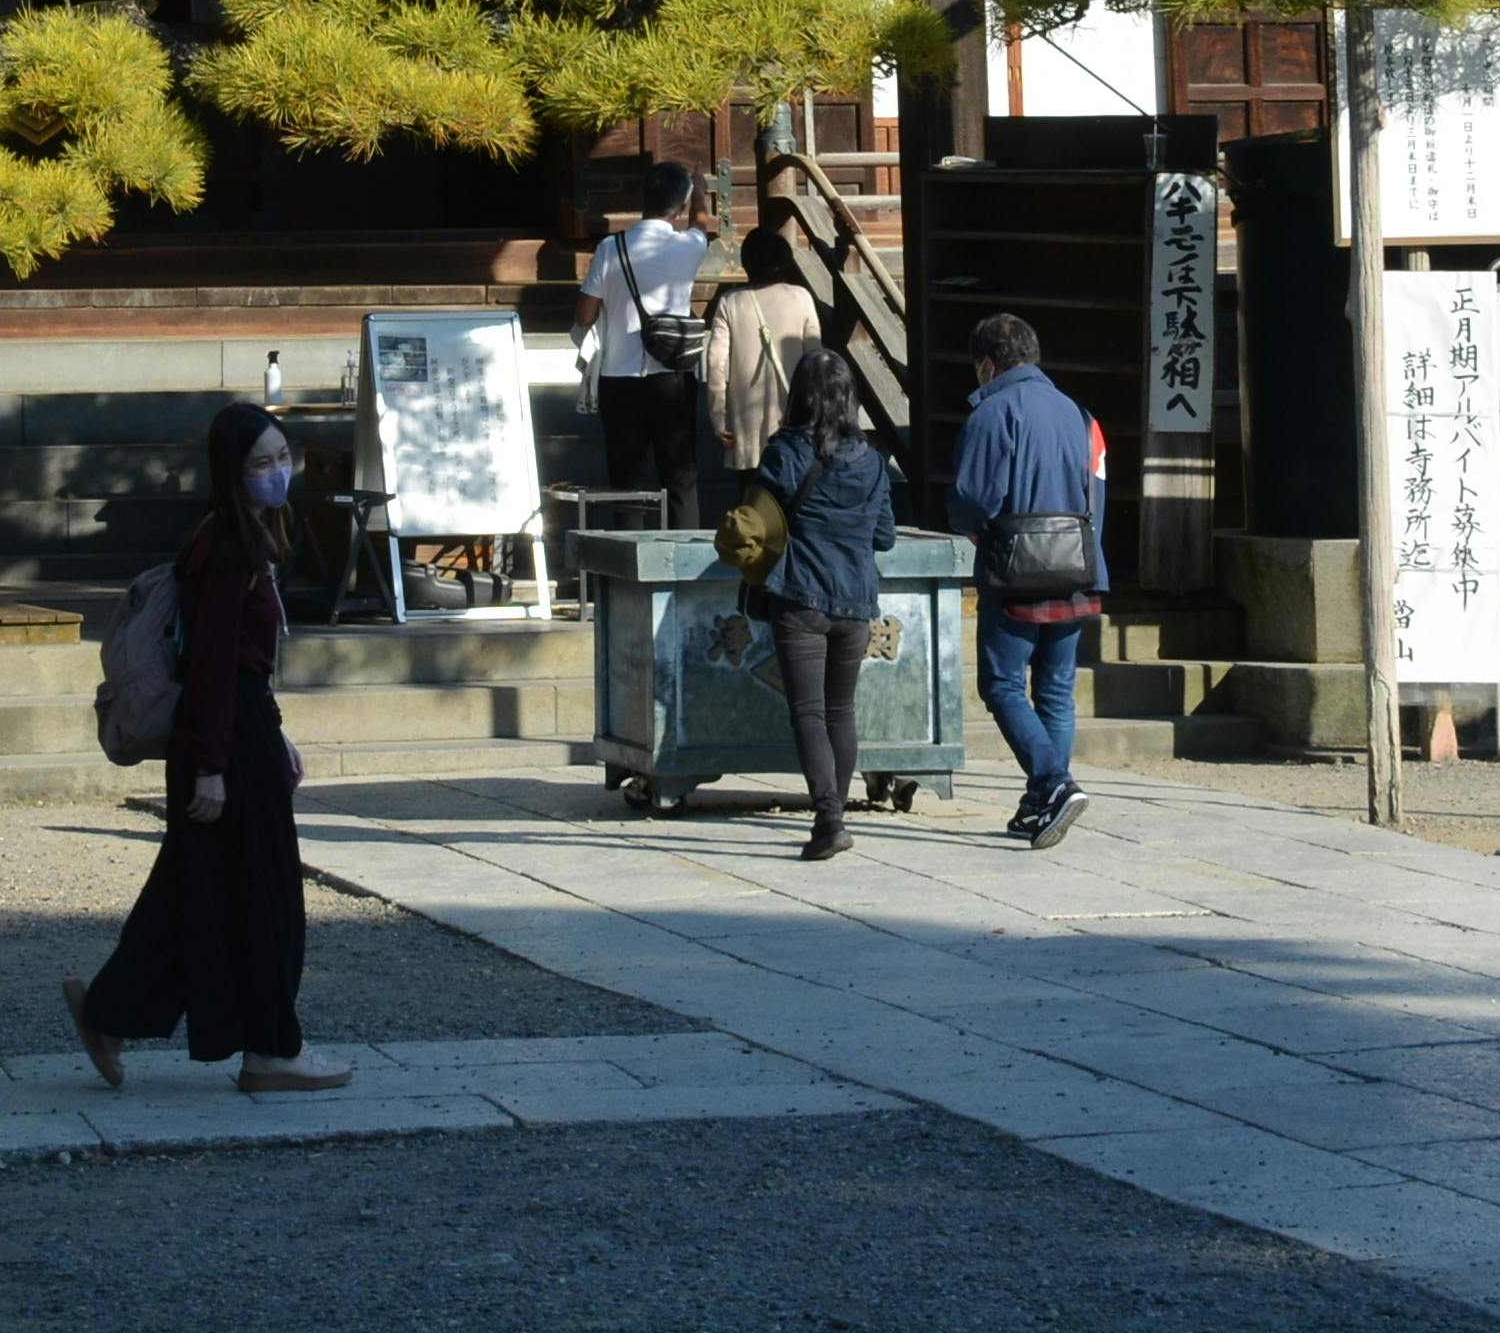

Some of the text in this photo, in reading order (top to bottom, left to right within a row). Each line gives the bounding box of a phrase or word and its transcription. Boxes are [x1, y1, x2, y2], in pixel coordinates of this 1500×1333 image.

[1449, 287, 1484, 612] 正月期アルバイト募集中
